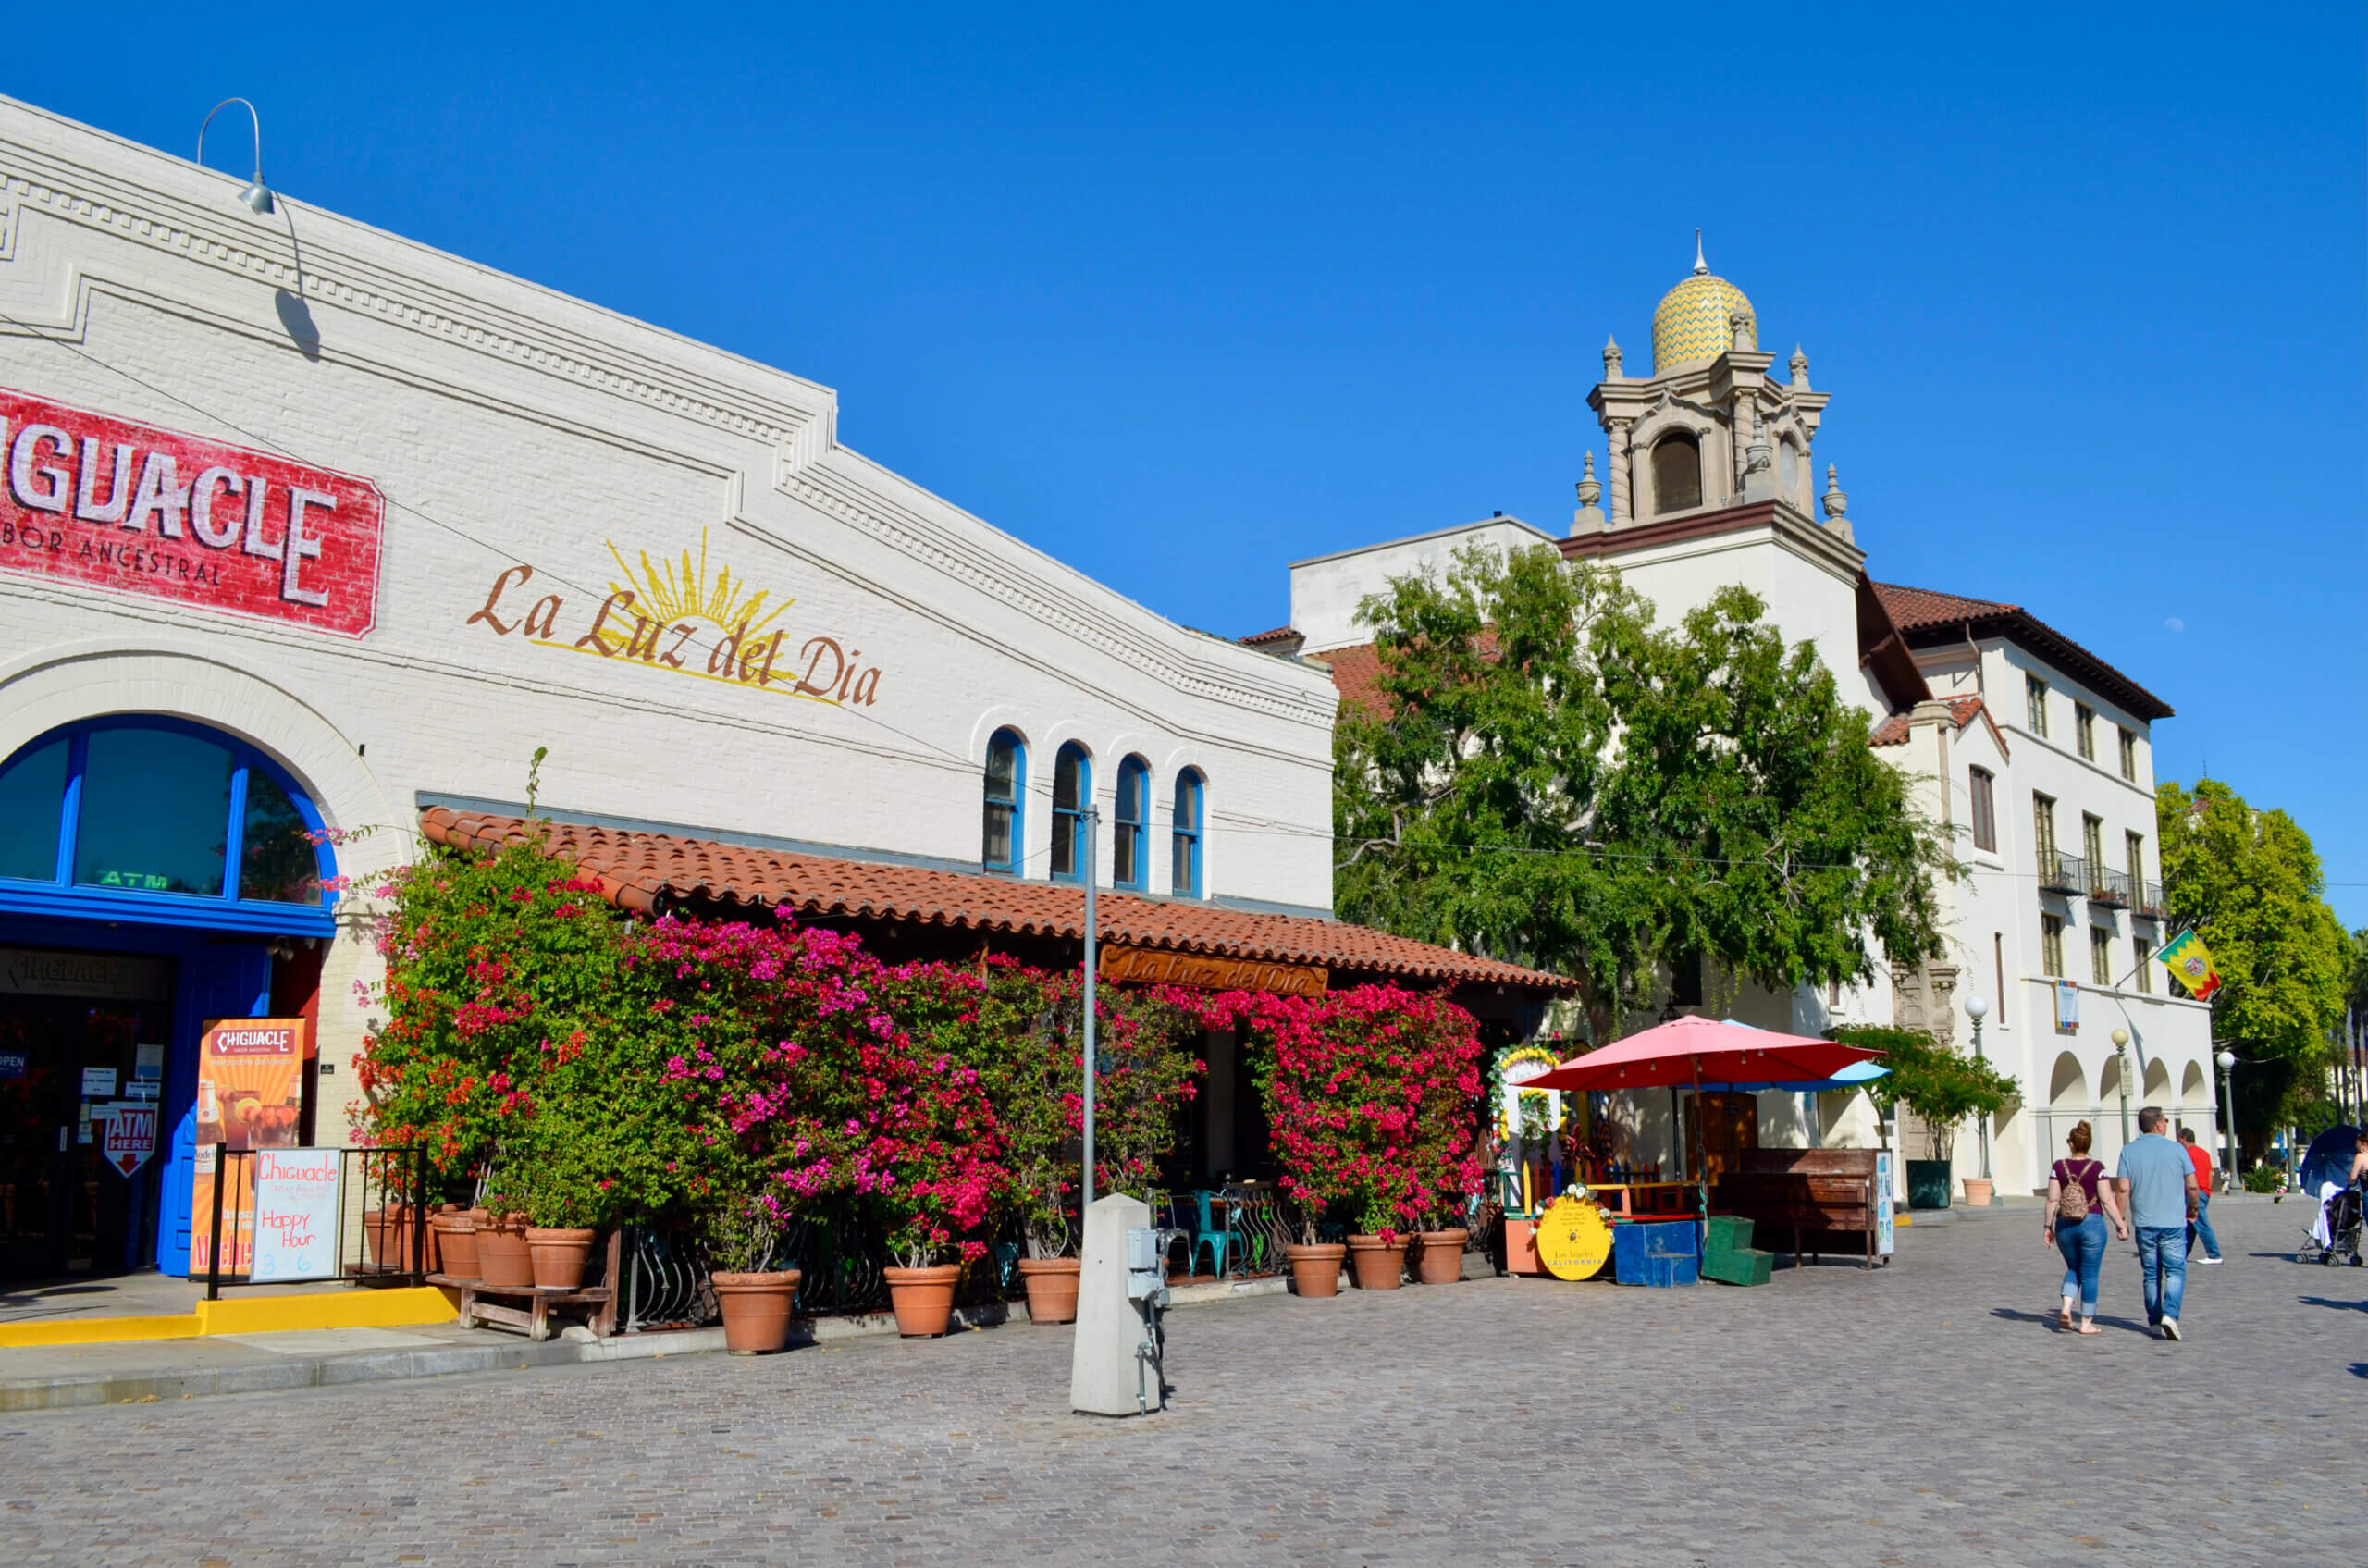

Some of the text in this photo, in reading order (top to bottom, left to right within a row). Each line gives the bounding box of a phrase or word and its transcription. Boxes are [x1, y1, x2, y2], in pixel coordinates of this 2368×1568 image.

[80, 540, 221, 586] ANCESTRAL
[465, 564, 882, 707] La Luz del Dia
[101, 870, 168, 889] ATM
[1123, 948, 1158, 980] La
[1162, 955, 1220, 986] Luz
[1224, 960, 1262, 990] del
[216, 1031, 290, 1053] CHIGUACLE
[109, 1112, 154, 1138] ATM
[110, 1139, 153, 1150] HERE
[262, 1208, 311, 1231] Happy
[282, 1230, 317, 1249] Hour
[260, 1253, 276, 1276] 3
[297, 1252, 312, 1273] 6
[1547, 1258, 1603, 1266] CALIFORNIA
